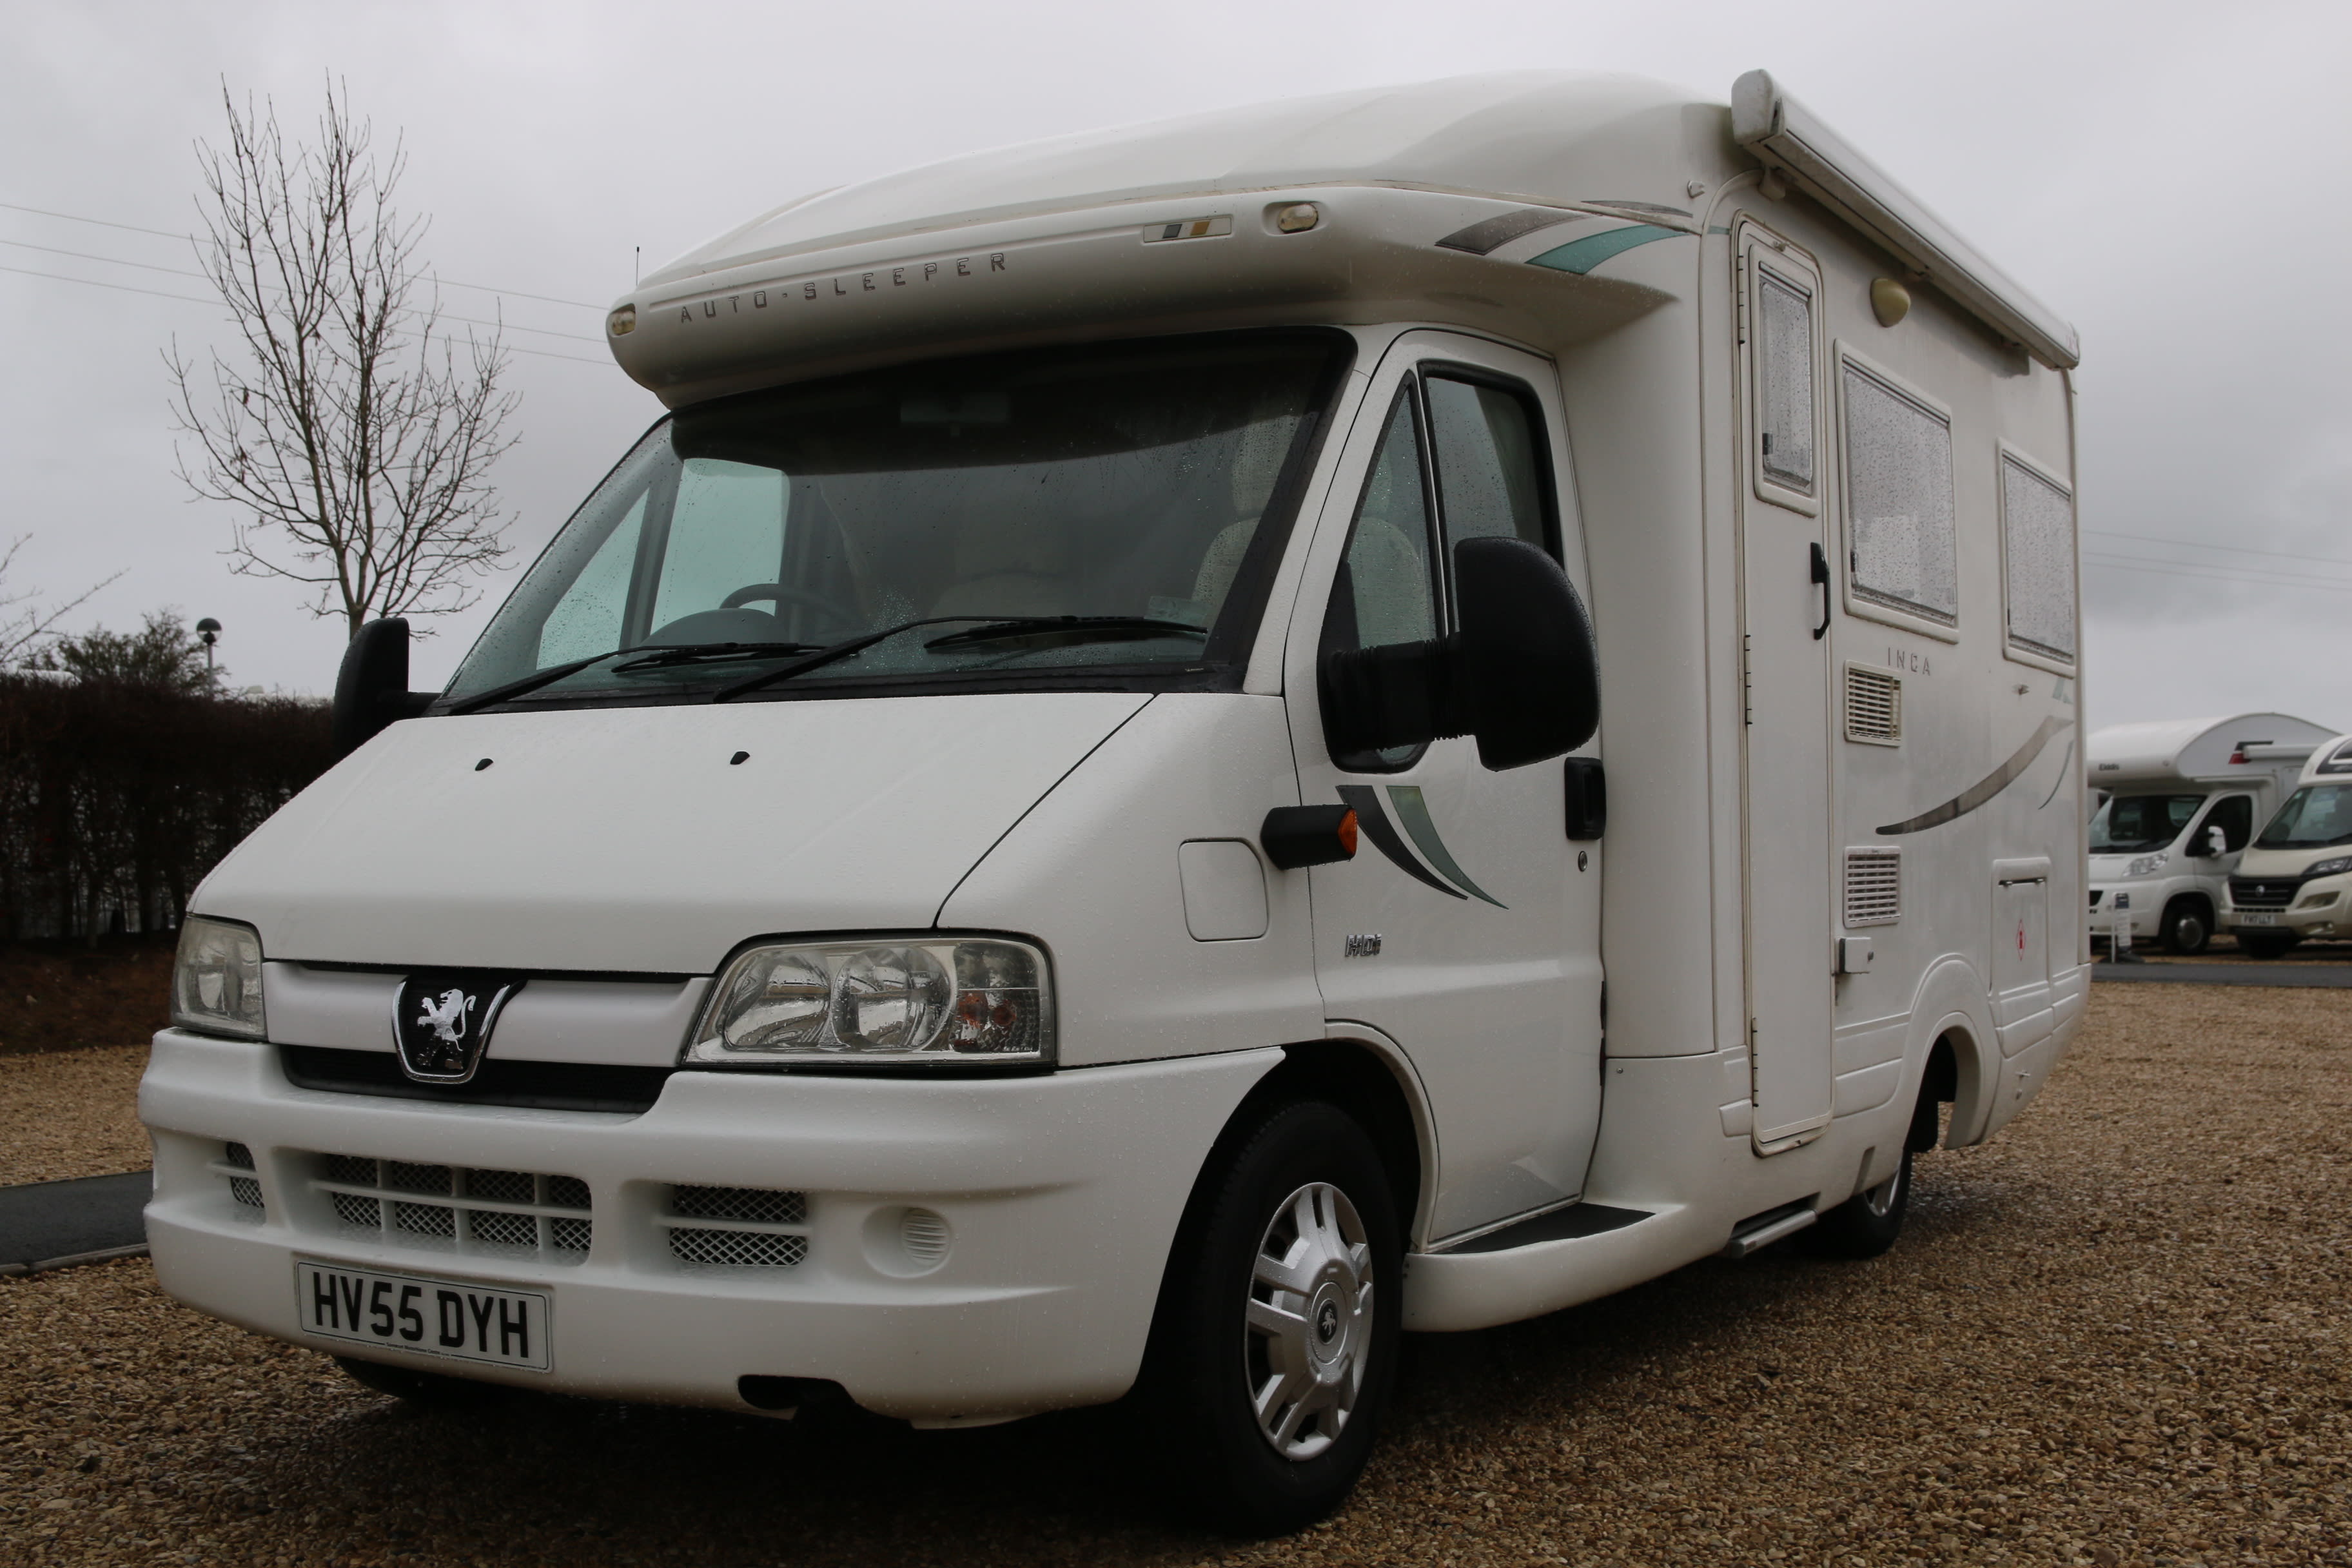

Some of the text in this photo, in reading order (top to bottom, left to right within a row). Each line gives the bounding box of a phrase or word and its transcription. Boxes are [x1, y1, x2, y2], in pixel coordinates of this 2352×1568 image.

[1888, 647, 1931, 676] INCA
[1345, 934, 1382, 957] HDi
[313, 1271, 529, 1358] HV55 DYH
